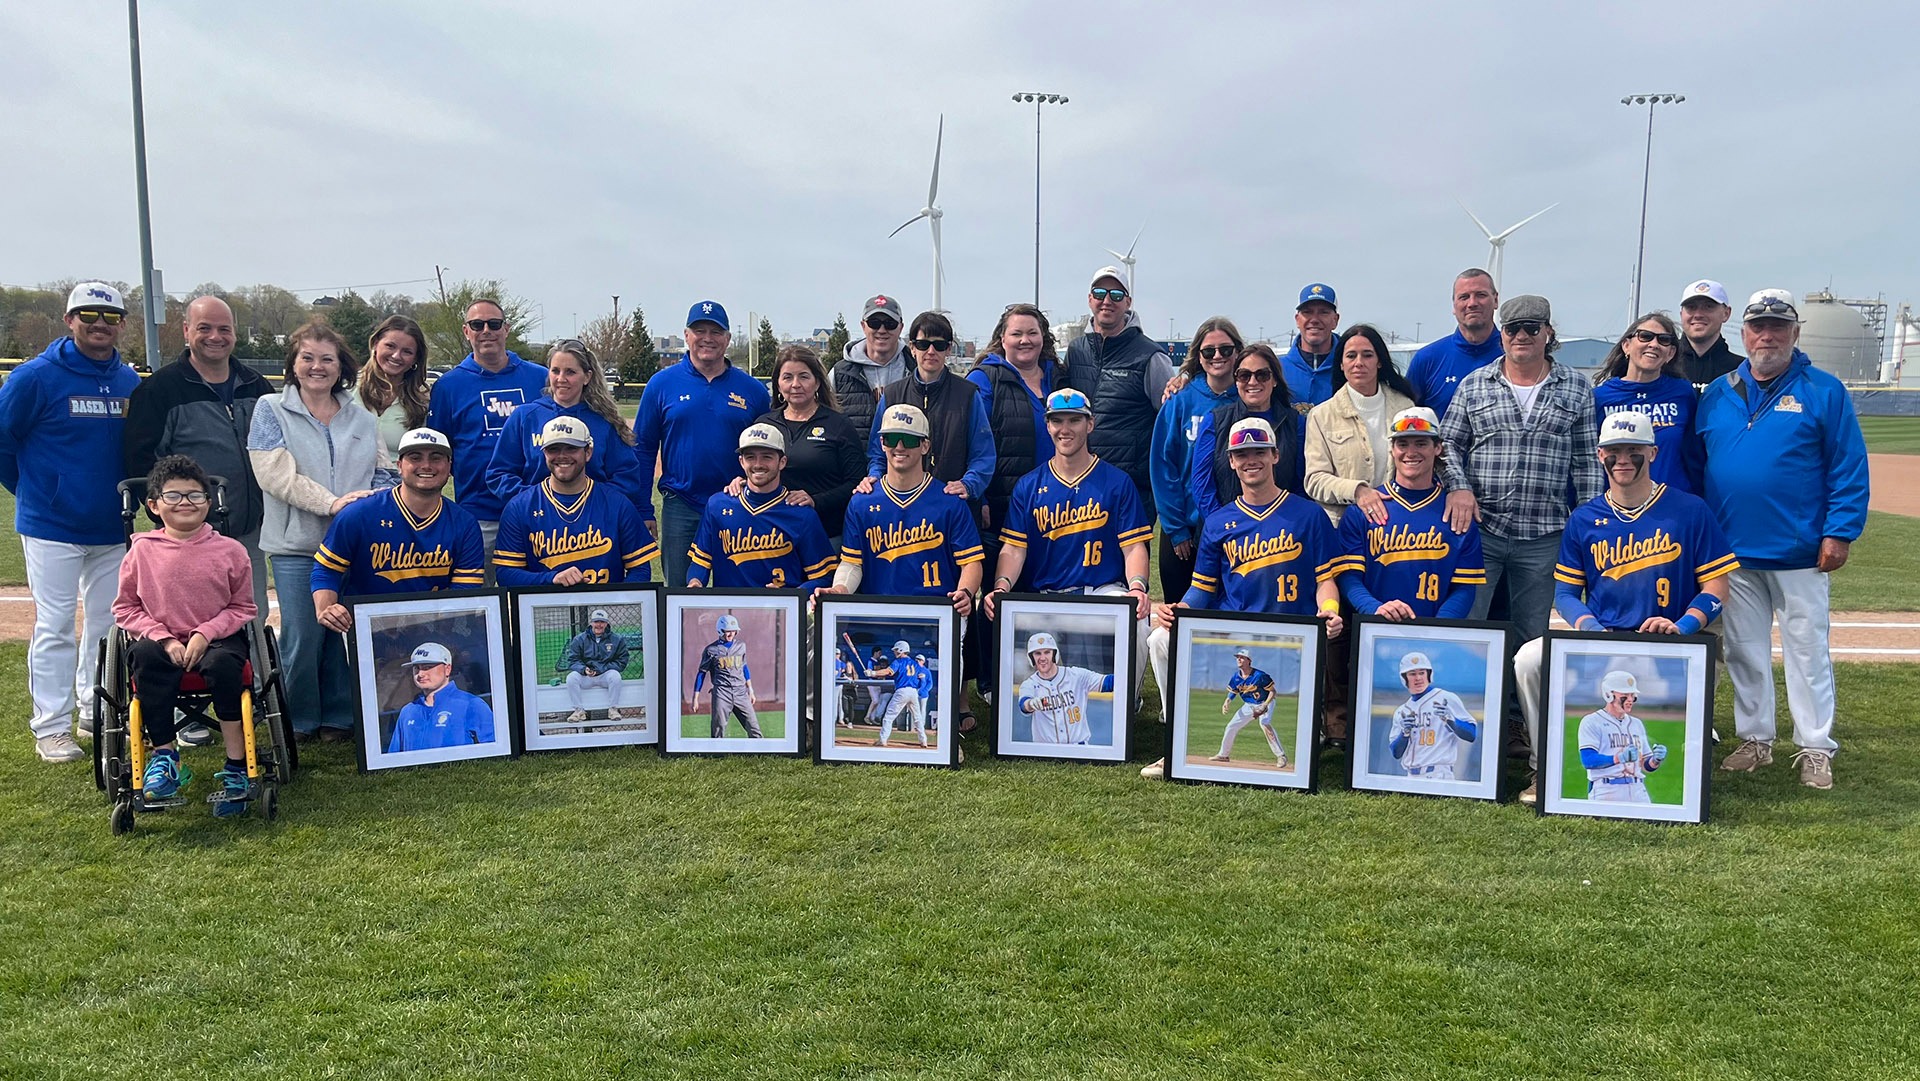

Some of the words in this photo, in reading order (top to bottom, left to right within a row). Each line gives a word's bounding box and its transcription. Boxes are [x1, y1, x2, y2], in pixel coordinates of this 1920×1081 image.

[87, 288, 113, 302] JWU
[71, 399, 123, 414] BASEBALL
[487, 397, 520, 416] JW
[892, 411, 913, 424] JWU
[551, 423, 573, 434] JWU
[748, 429, 769, 440] JWU
[1611, 420, 1636, 432] JWU
[1032, 497, 1102, 532] Wildcats
[528, 524, 604, 557] Wildcats
[718, 526, 785, 554] Wildcats
[865, 518, 937, 553] Wildcats
[1223, 529, 1295, 567] Wildcats
[1367, 523, 1443, 556] Wildcats
[1591, 528, 1672, 571] Wildcats
[370, 542, 453, 570] Wildcats
[1082, 540, 1103, 567] 16
[921, 560, 941, 588] 11
[1276, 574, 1298, 602] 13
[1416, 571, 1439, 601] 18
[1655, 577, 1670, 608] 9
[1066, 705, 1081, 725] 16
[1419, 728, 1435, 746] 18
